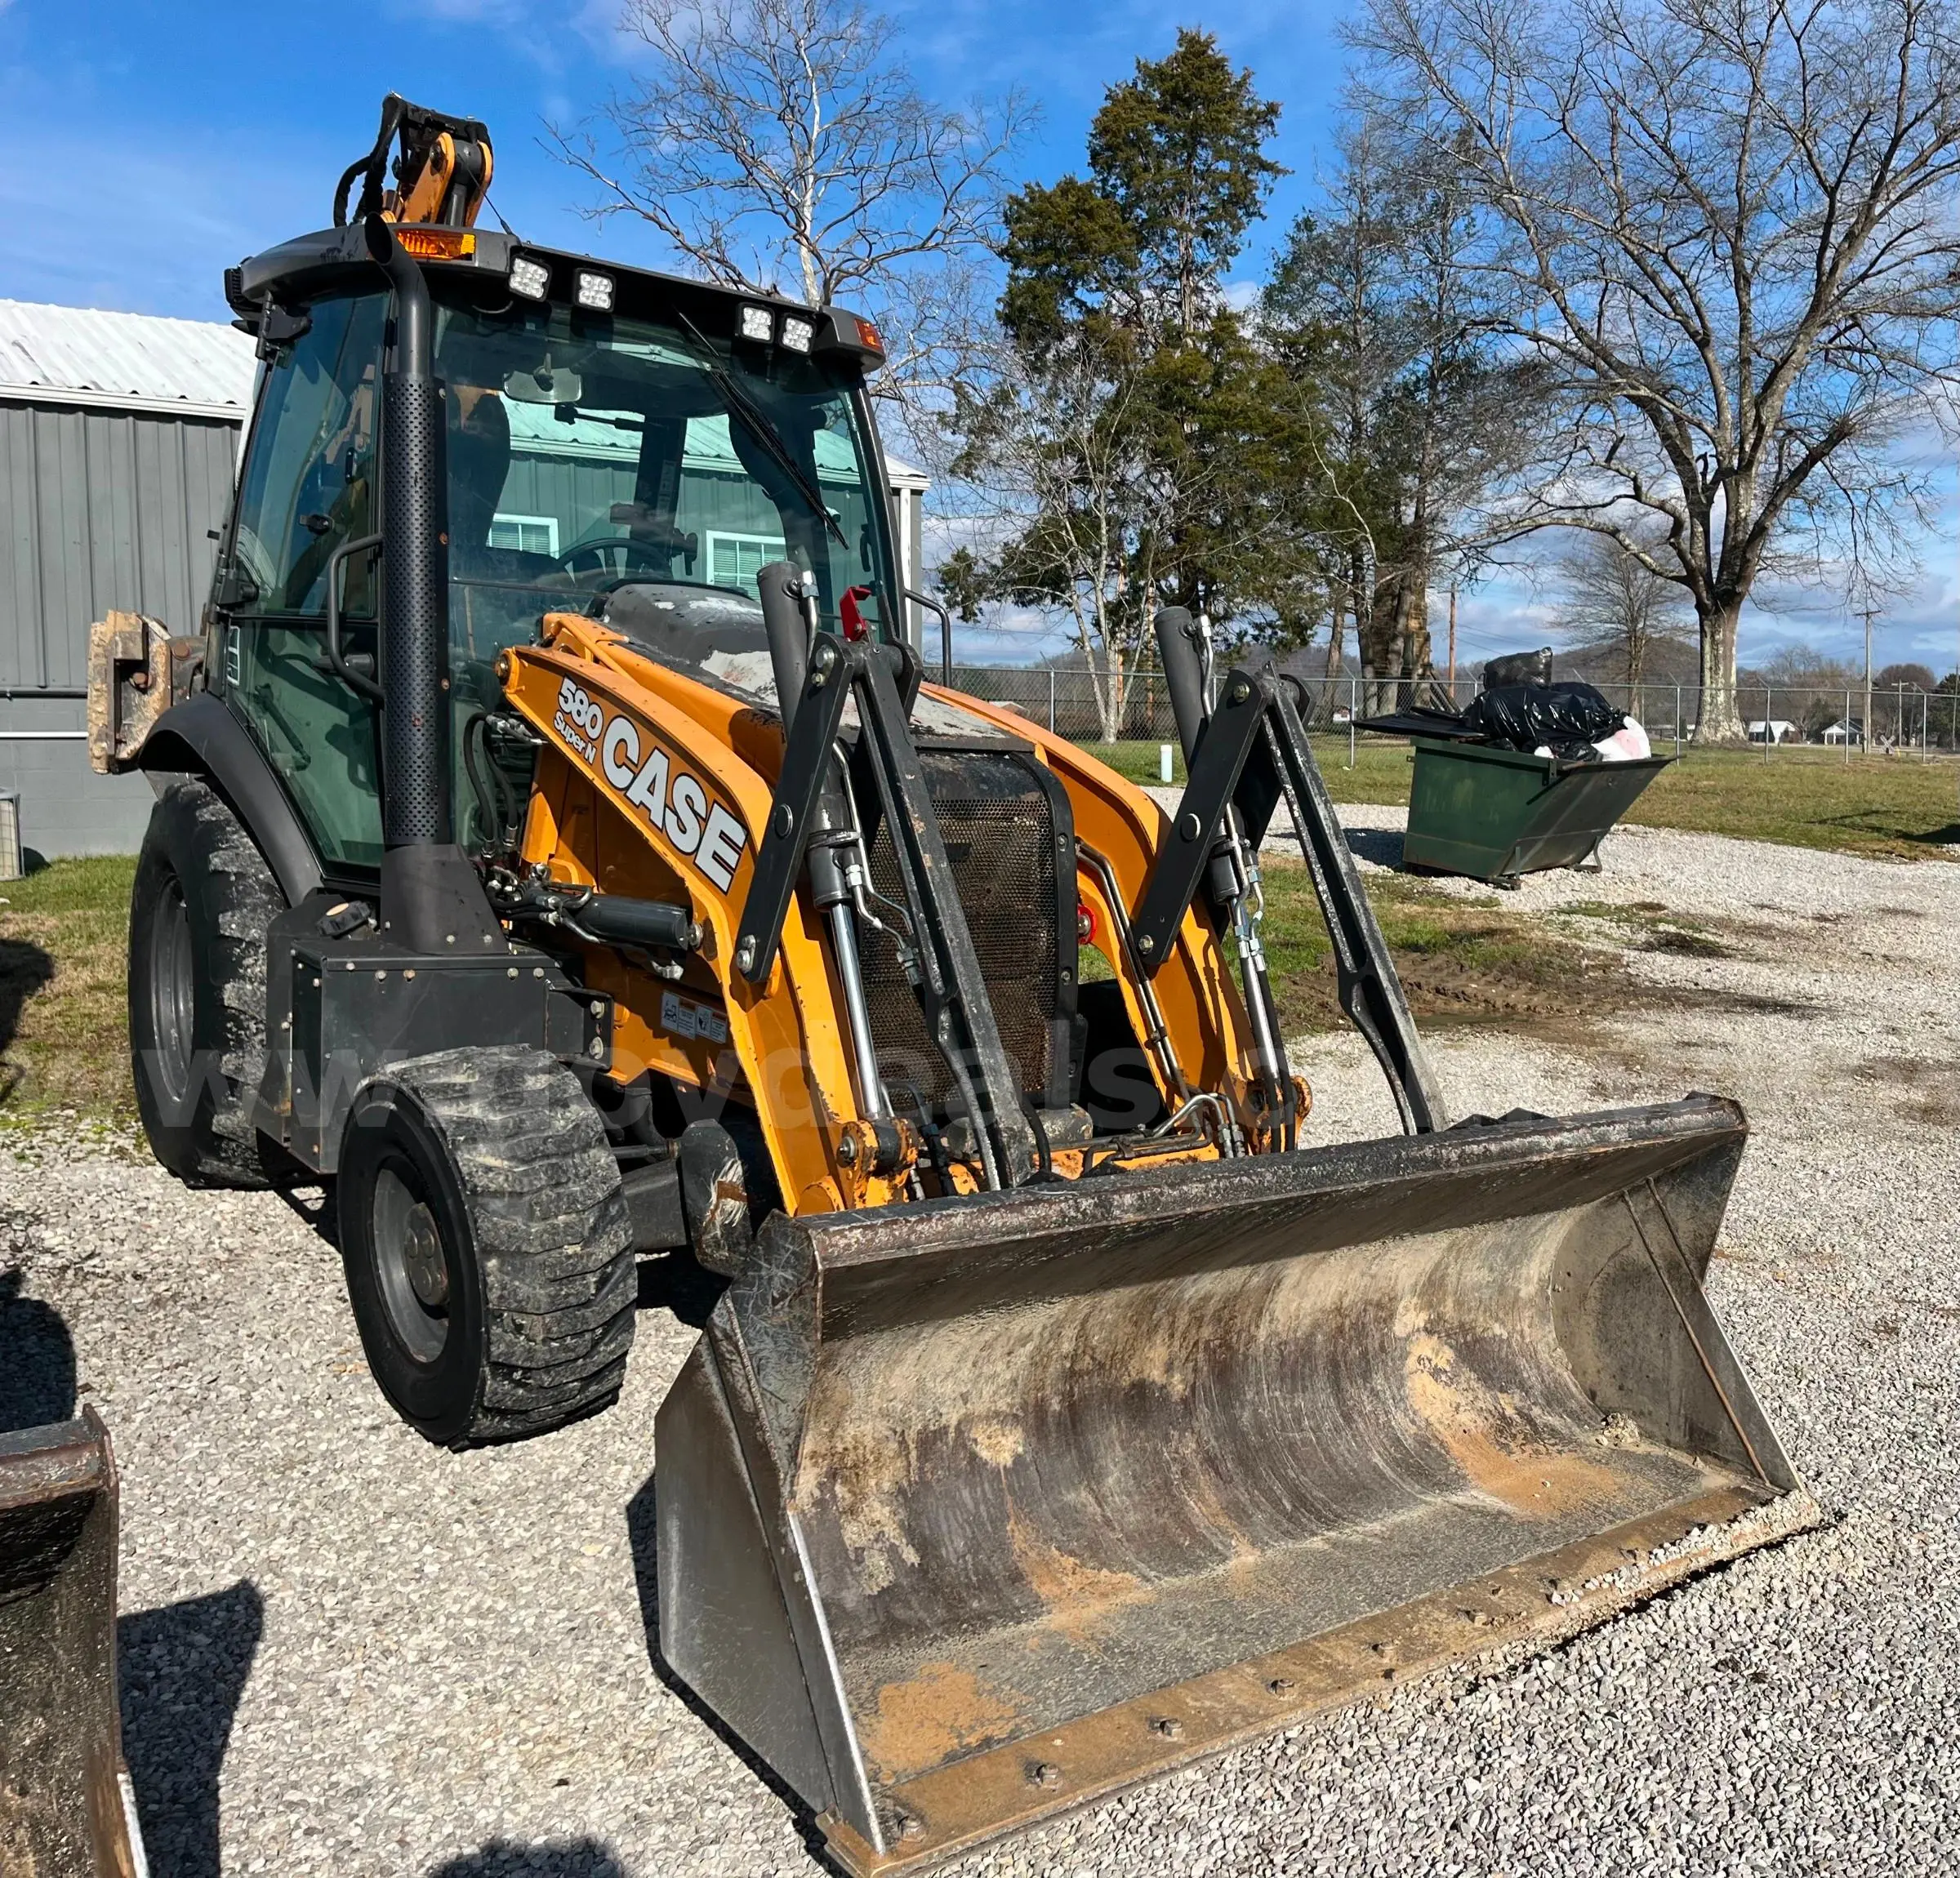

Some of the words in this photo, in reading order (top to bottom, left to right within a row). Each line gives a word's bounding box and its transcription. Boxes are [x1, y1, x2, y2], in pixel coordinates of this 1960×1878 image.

[554, 710, 586, 753] Super
[584, 741, 597, 765] N
[558, 676, 603, 741] 580
[602, 714, 748, 895] CASE
